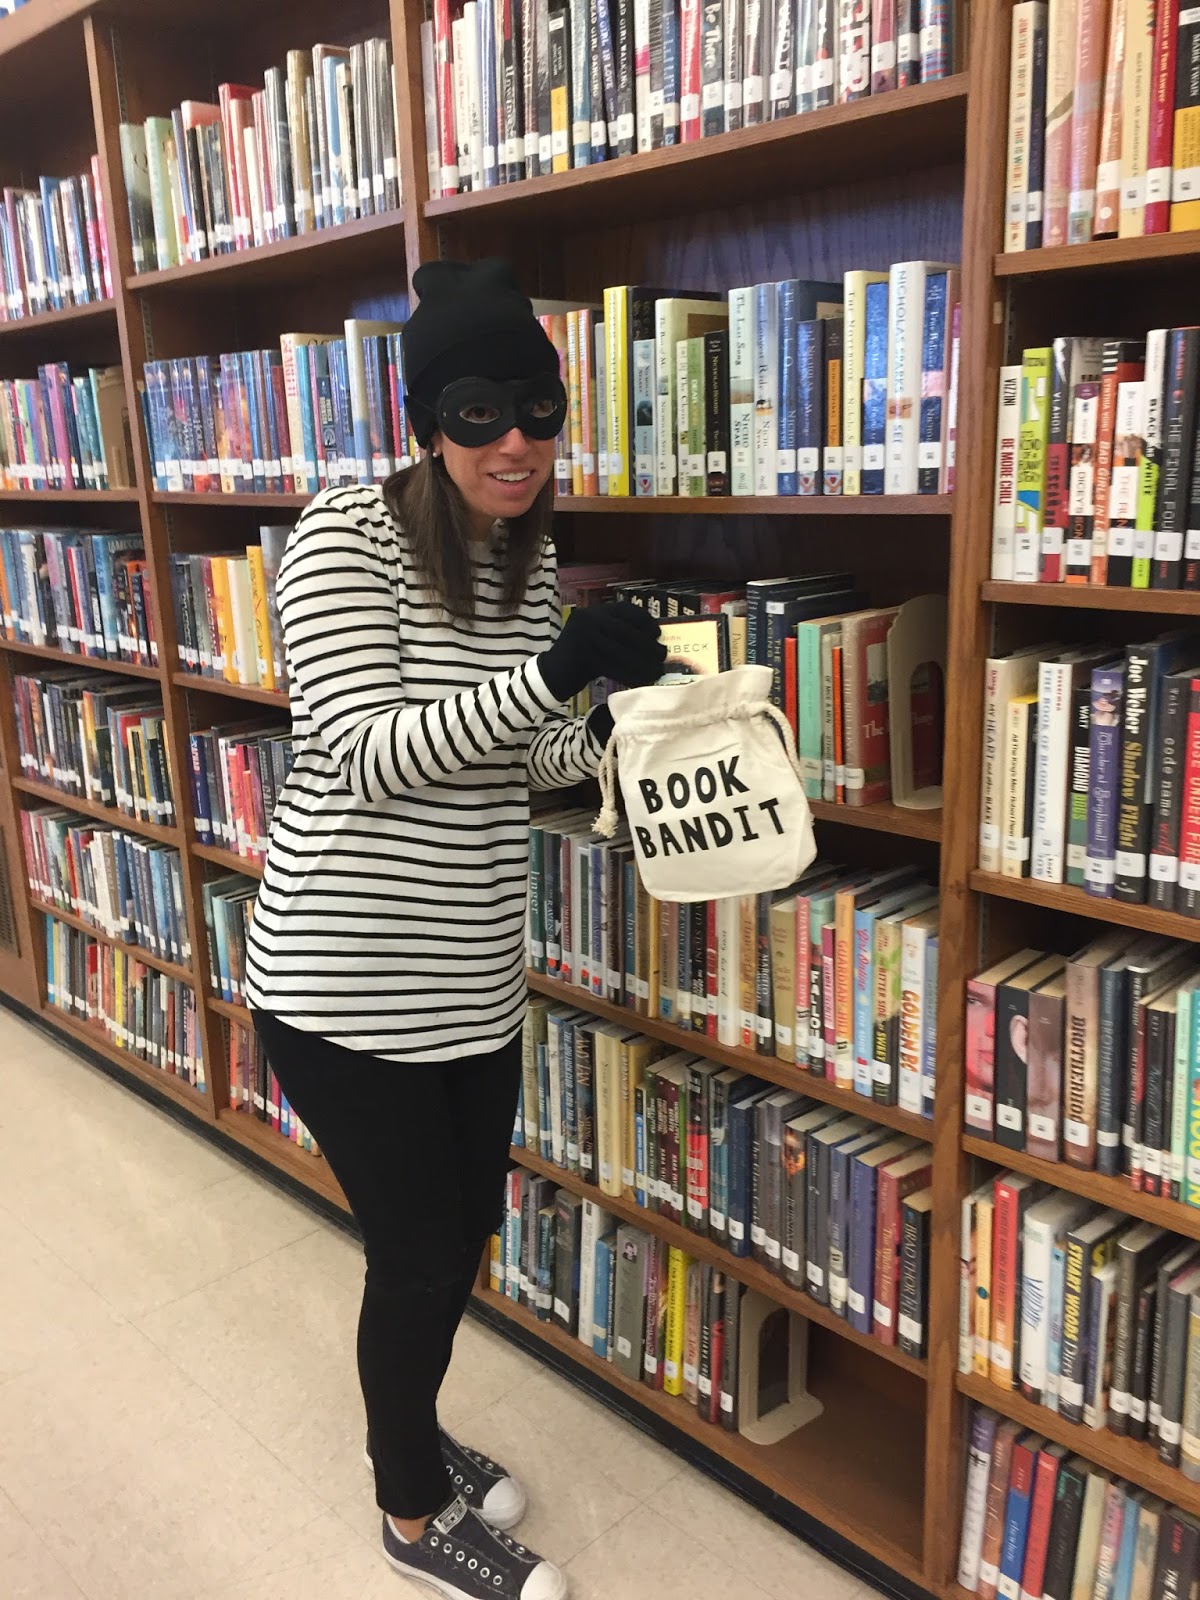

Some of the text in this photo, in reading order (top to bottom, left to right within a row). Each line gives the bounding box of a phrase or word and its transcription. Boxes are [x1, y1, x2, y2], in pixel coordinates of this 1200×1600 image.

[603, 65, 614, 90] LOVE
[895, 270, 907, 341] NICHOLAS
[733, 294, 746, 366] The Last Song
[742, 413, 751, 448] NICHO
[926, 408, 936, 443] NICHOL
[999, 378, 1017, 506] VIZZINI BE MORE CHILL
[1143, 398, 1158, 497] BLACK WHITE
[1098, 441, 1111, 463] BAD
[1159, 415, 1183, 533] THE FINAL FOU
[1096, 468, 1110, 501] GIRLS
[986, 719, 997, 762] HEART
[1072, 705, 1090, 821] WATT DIAMOND DOGS
[1119, 655, 1148, 847] Joe Weber Shadow Flight
[1161, 737, 1177, 774] code
[638, 755, 750, 814] BOOK
[1158, 780, 1174, 817] name
[635, 798, 784, 858] BANDIT
[529, 870, 541, 914] linger
[626, 912, 635, 951] shiver
[857, 929, 870, 953] Girl
[878, 1000, 888, 1018] SIDE
[901, 990, 920, 1052] GOLDEN
[576, 1035, 591, 1059] AMY
[876, 1030, 887, 1062] SWEET
[1070, 1015, 1086, 1123] BROTHERHOO
[904, 1223, 918, 1294] BRAD THOR
[1066, 1241, 1084, 1293] STUART
[1063, 1293, 1081, 1341] WOODS
